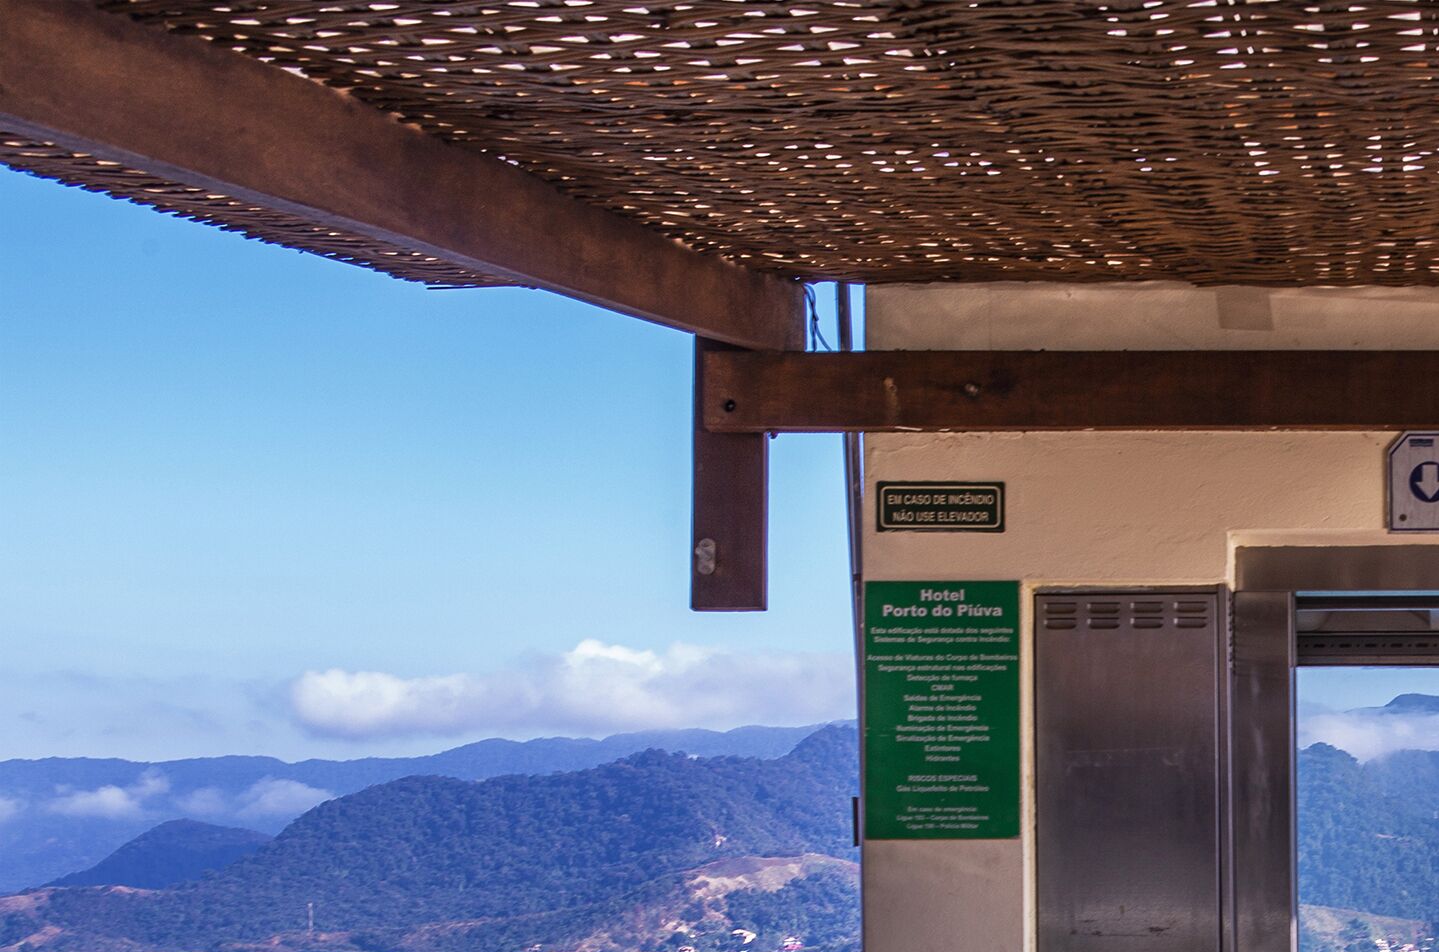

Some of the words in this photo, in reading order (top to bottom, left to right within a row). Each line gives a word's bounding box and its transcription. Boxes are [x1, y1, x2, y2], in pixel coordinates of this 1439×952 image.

[887, 494, 902, 505] EM
[904, 494, 931, 505] CASO
[933, 494, 946, 505] DE
[948, 492, 994, 505] INCÊNDIO
[892, 509, 914, 522] NÃO
[916, 511, 936, 522] USE
[937, 511, 989, 522] ELEVADOR
[920, 589, 965, 601] Hotel
[882, 604, 928, 617] Porto
[931, 604, 953, 617] do
[957, 604, 1003, 617] Piúva
